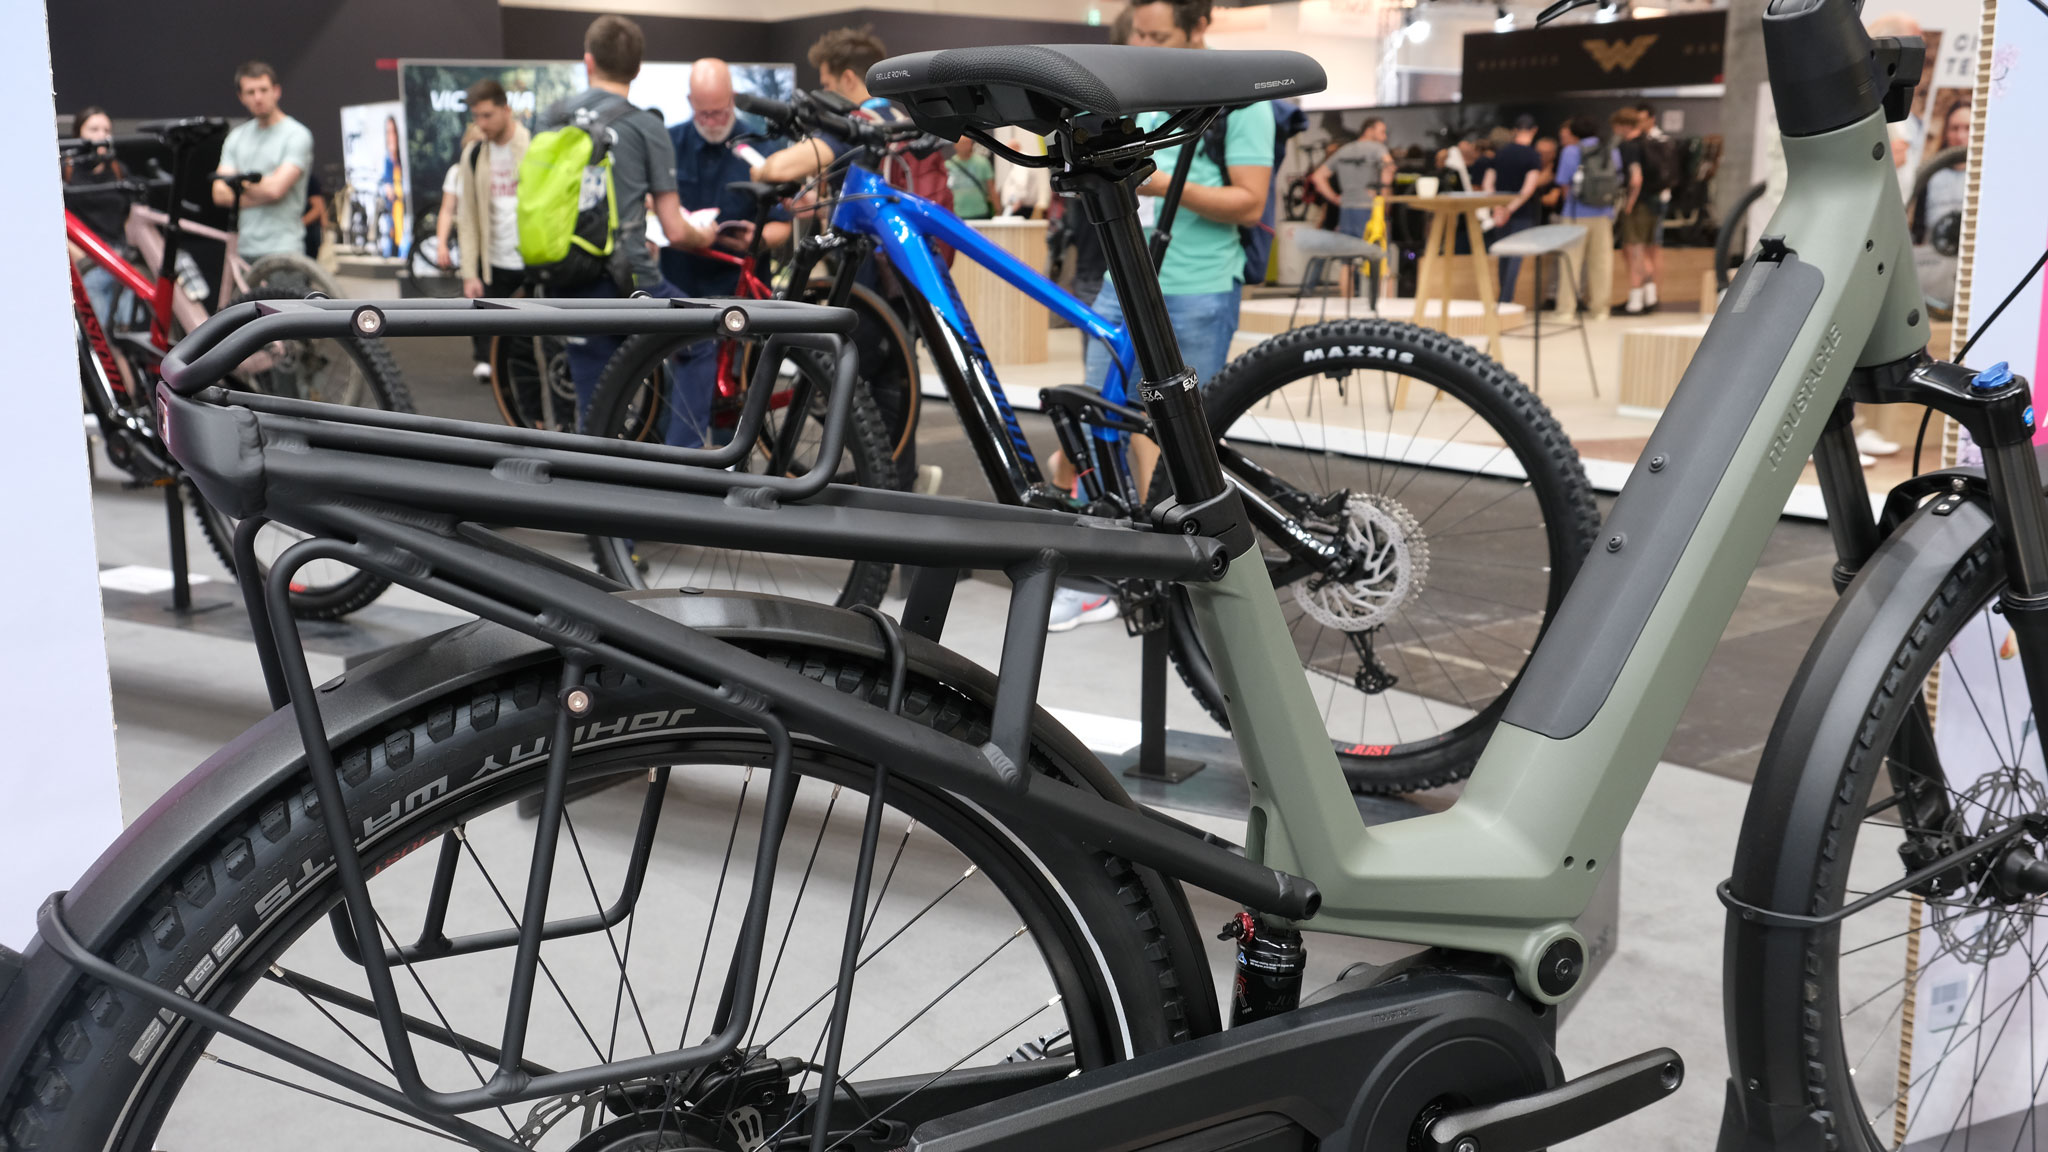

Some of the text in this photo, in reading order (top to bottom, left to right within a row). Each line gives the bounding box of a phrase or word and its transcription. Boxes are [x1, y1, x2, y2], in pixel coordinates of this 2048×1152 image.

[875, 69, 911, 81] SELLE ROYAL
[1254, 78, 1296, 90] ESSENZA
[430, 89, 536, 113] VICIA
[1303, 345, 1415, 364] MAXXIS
[1141, 390, 1165, 401] EXA
[1769, 322, 1842, 472] MOUSTACHE
[1343, 744, 1395, 757] JUST
[254, 775, 449, 922] WATS
